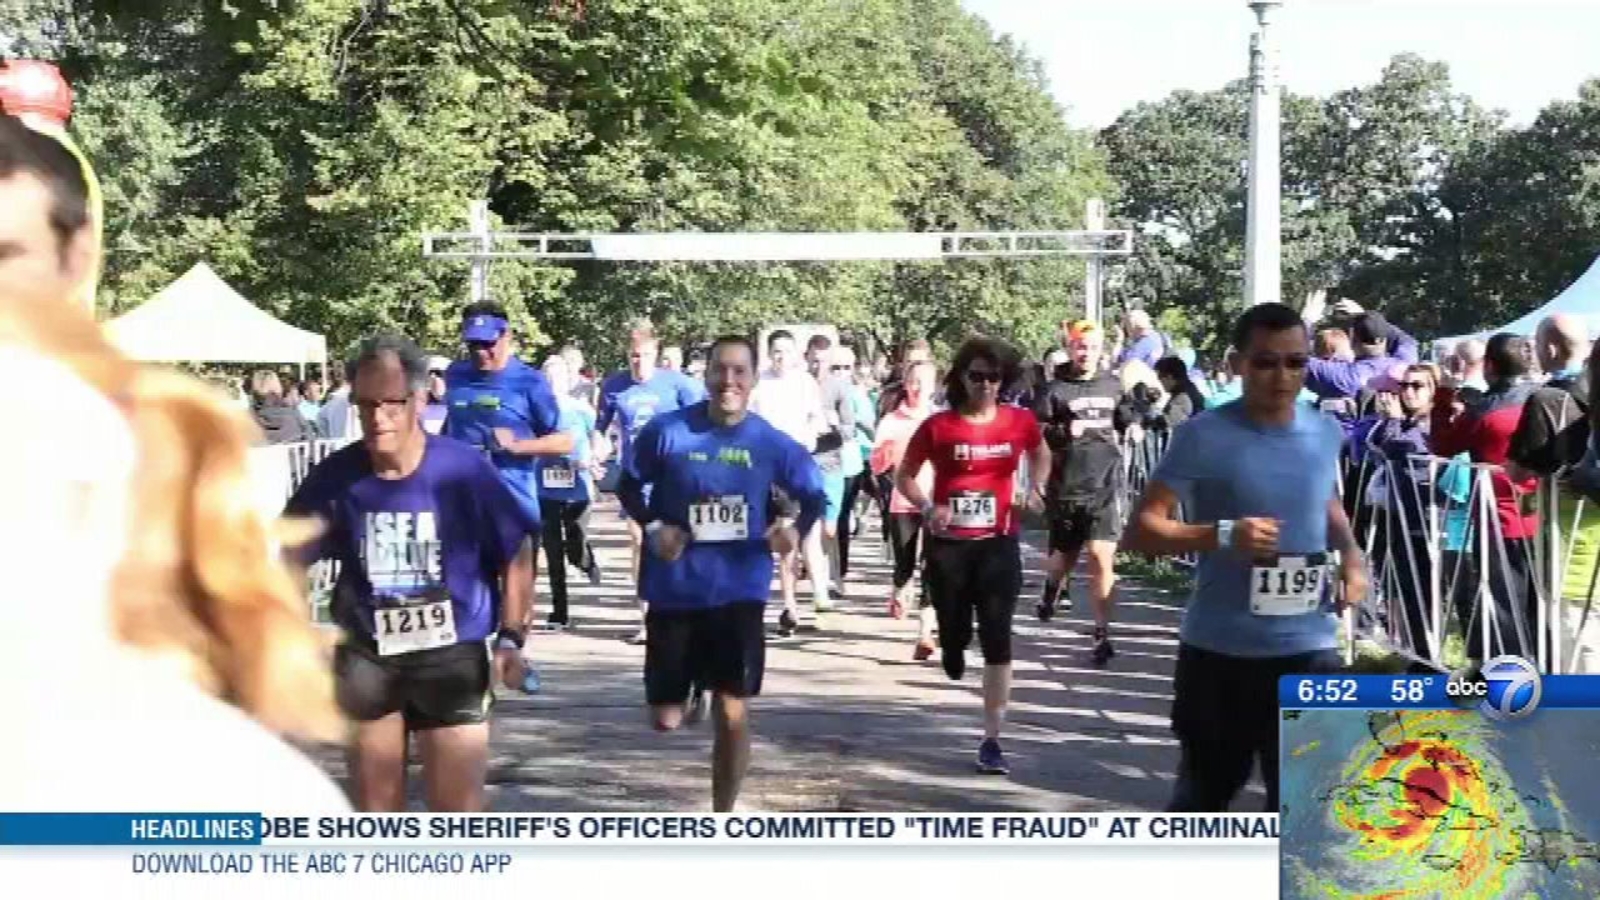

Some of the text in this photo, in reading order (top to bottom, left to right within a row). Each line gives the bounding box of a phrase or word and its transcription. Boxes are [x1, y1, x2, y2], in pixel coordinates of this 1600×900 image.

[692, 504, 744, 525] 1102
[952, 497, 993, 515] 1276
[1258, 569, 1320, 595] 1199
[381, 604, 447, 636] 1219
